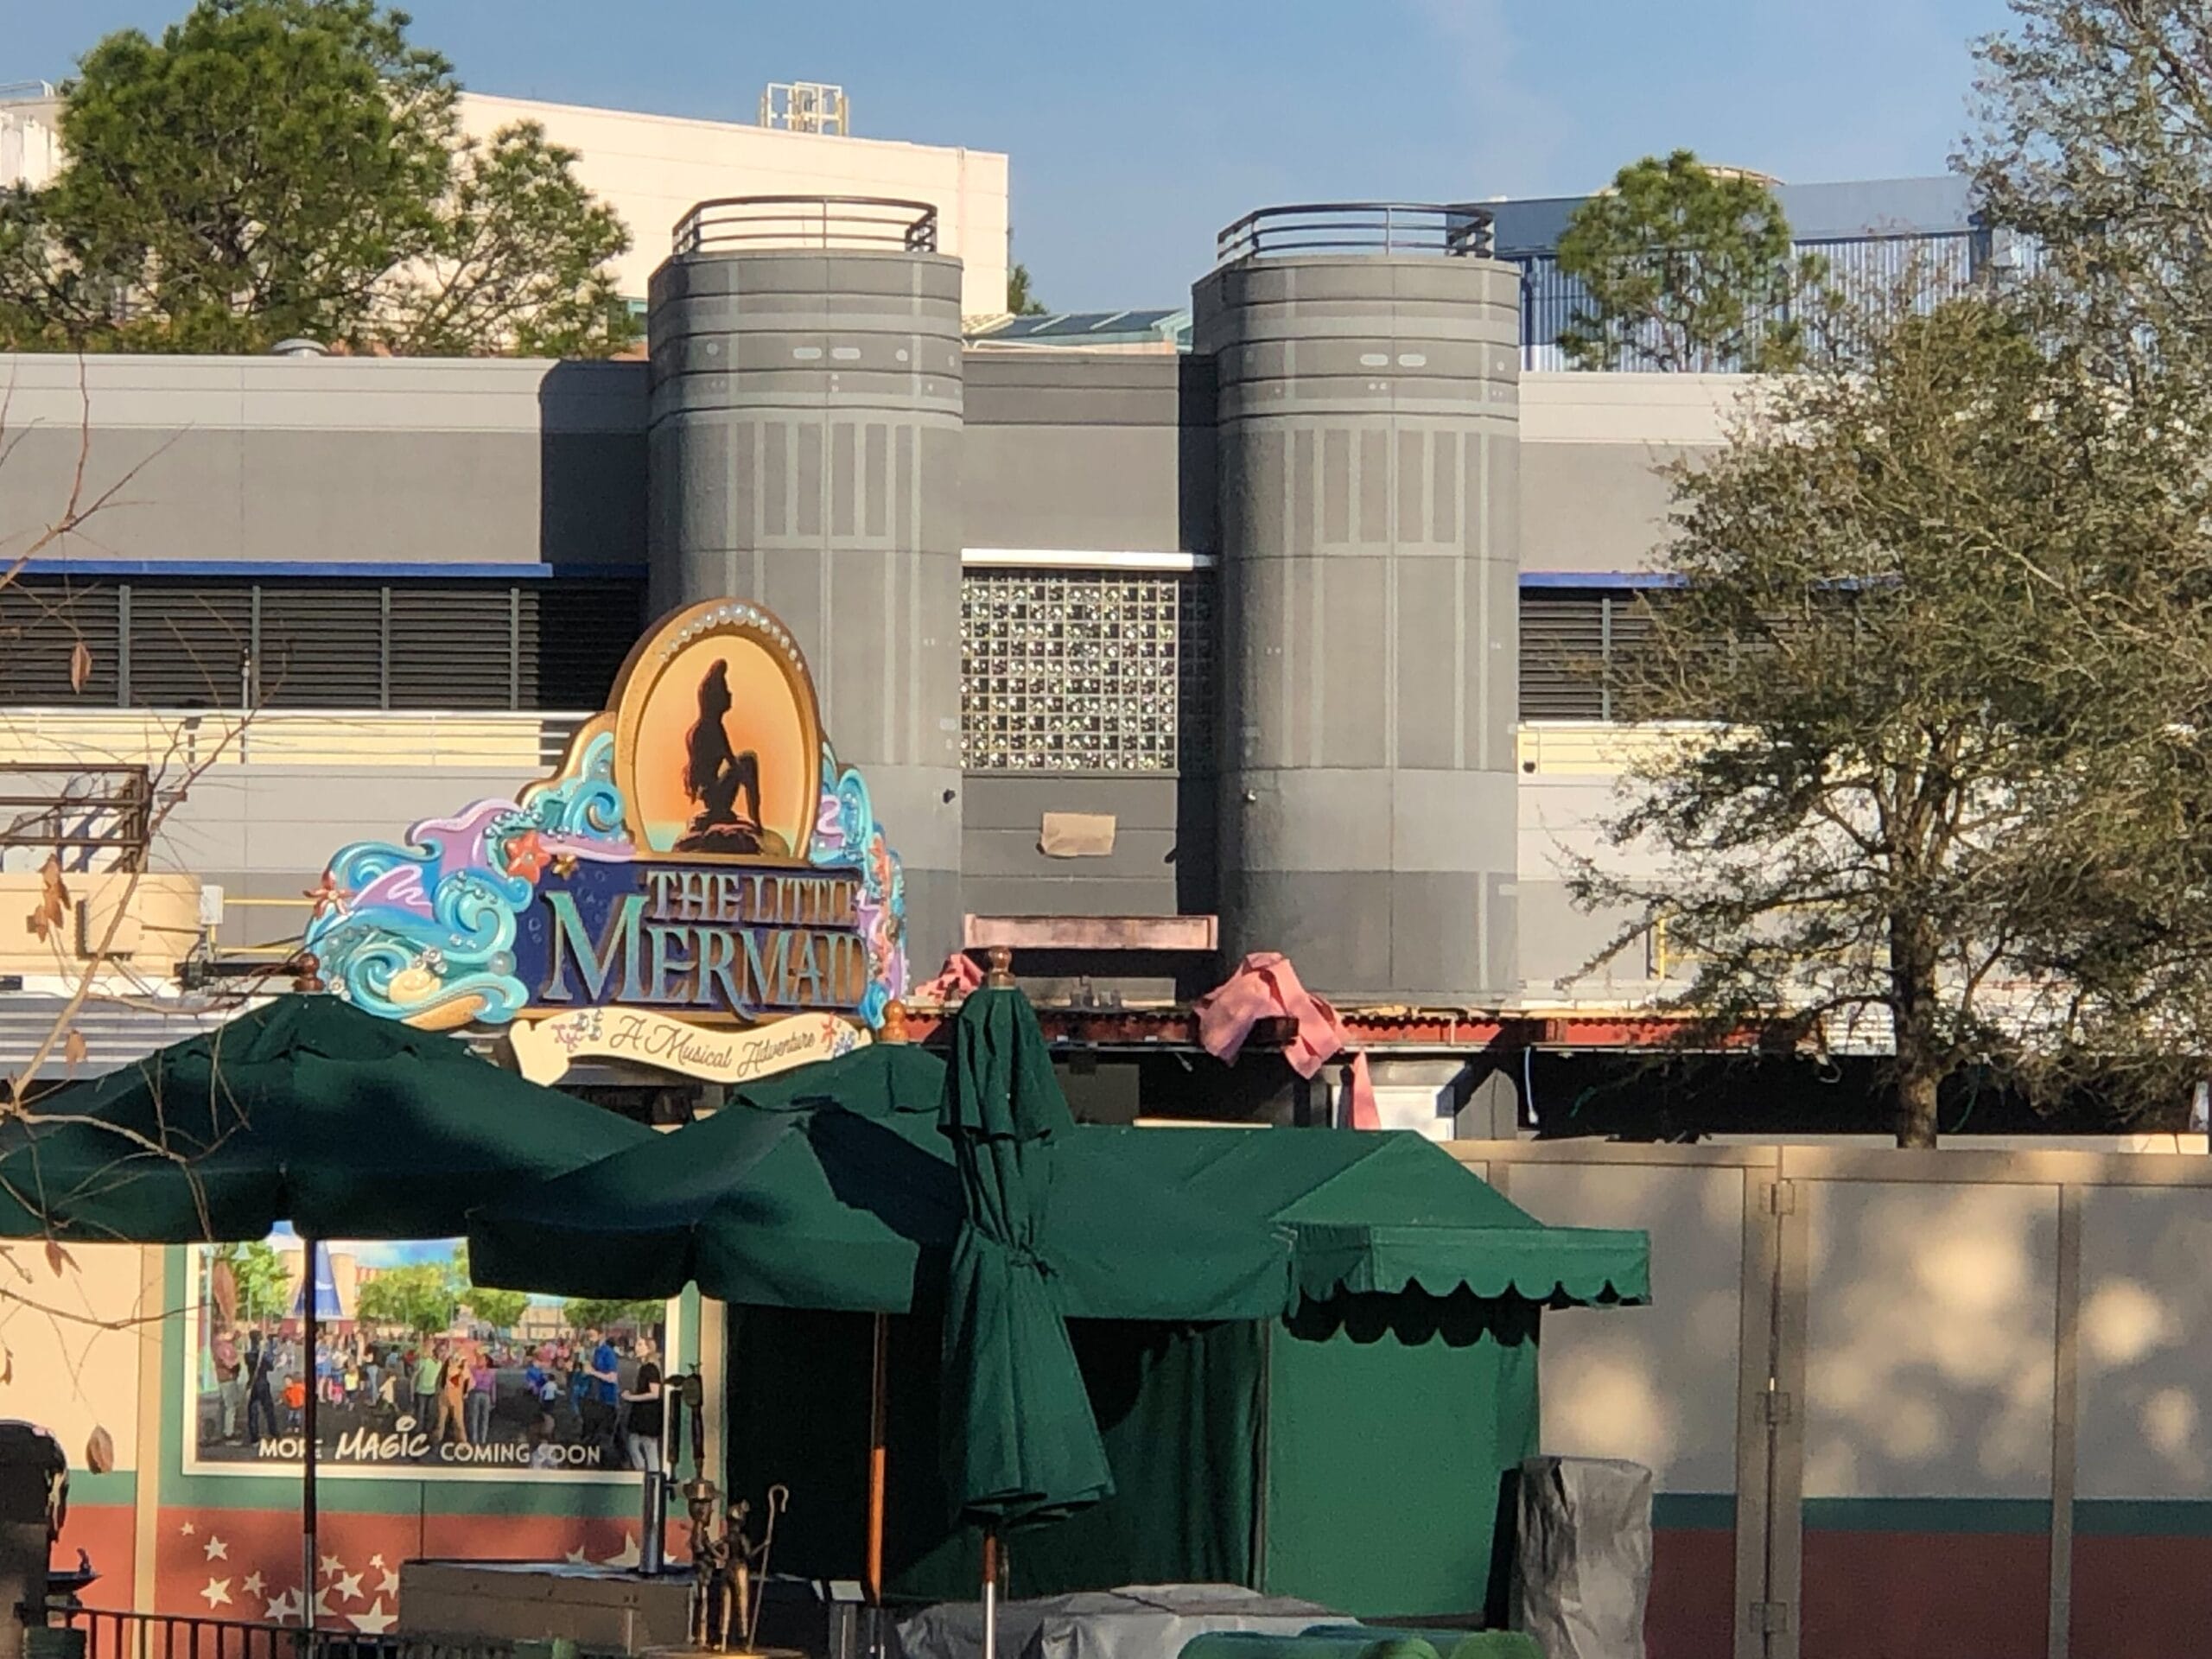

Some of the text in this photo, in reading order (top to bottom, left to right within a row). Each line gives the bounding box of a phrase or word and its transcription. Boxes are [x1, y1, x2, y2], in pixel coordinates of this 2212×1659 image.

[645, 870, 859, 925] THE LITTLE
[541, 890, 868, 1021] MERMAID
[609, 1014, 816, 1077] A Musical Adventure
[334, 1415, 431, 1462] MAGIC
[440, 1441, 531, 1464] COMING
[537, 1442, 601, 1465] SOON
